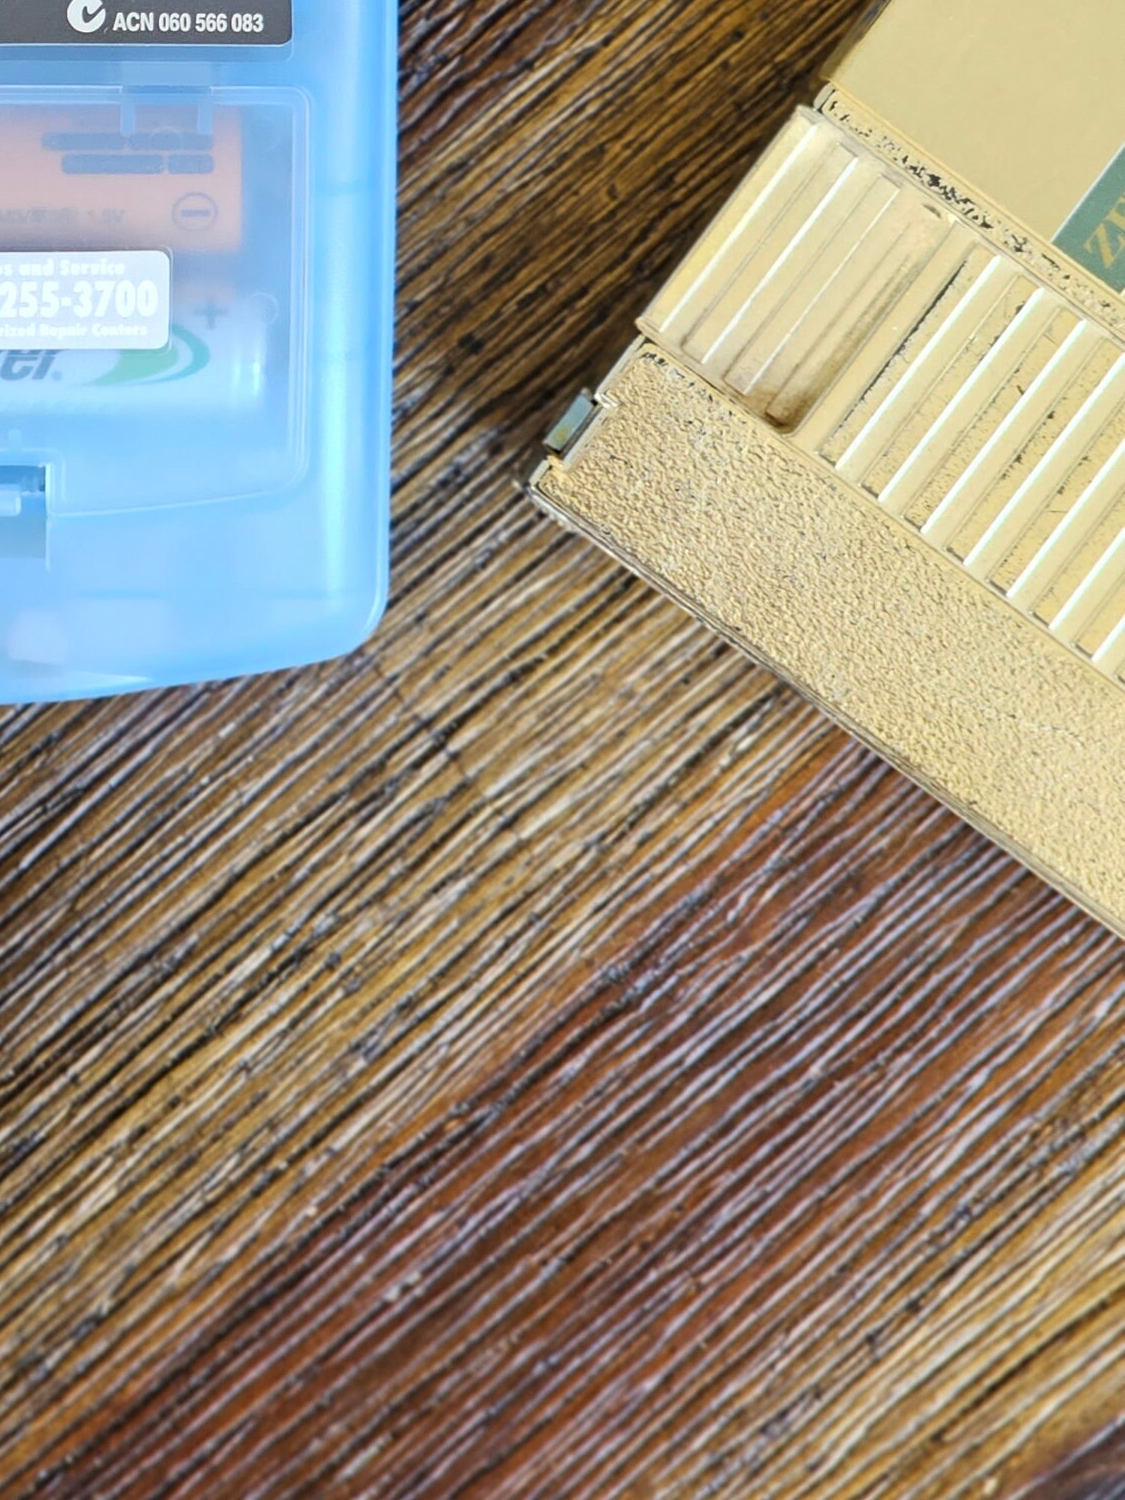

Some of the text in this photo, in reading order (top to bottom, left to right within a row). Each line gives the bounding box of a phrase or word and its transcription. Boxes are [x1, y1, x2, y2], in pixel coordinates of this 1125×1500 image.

[112, 11, 263, 32] ACN 060 566 083
[18, 258, 54, 276] and
[60, 257, 126, 276] Service
